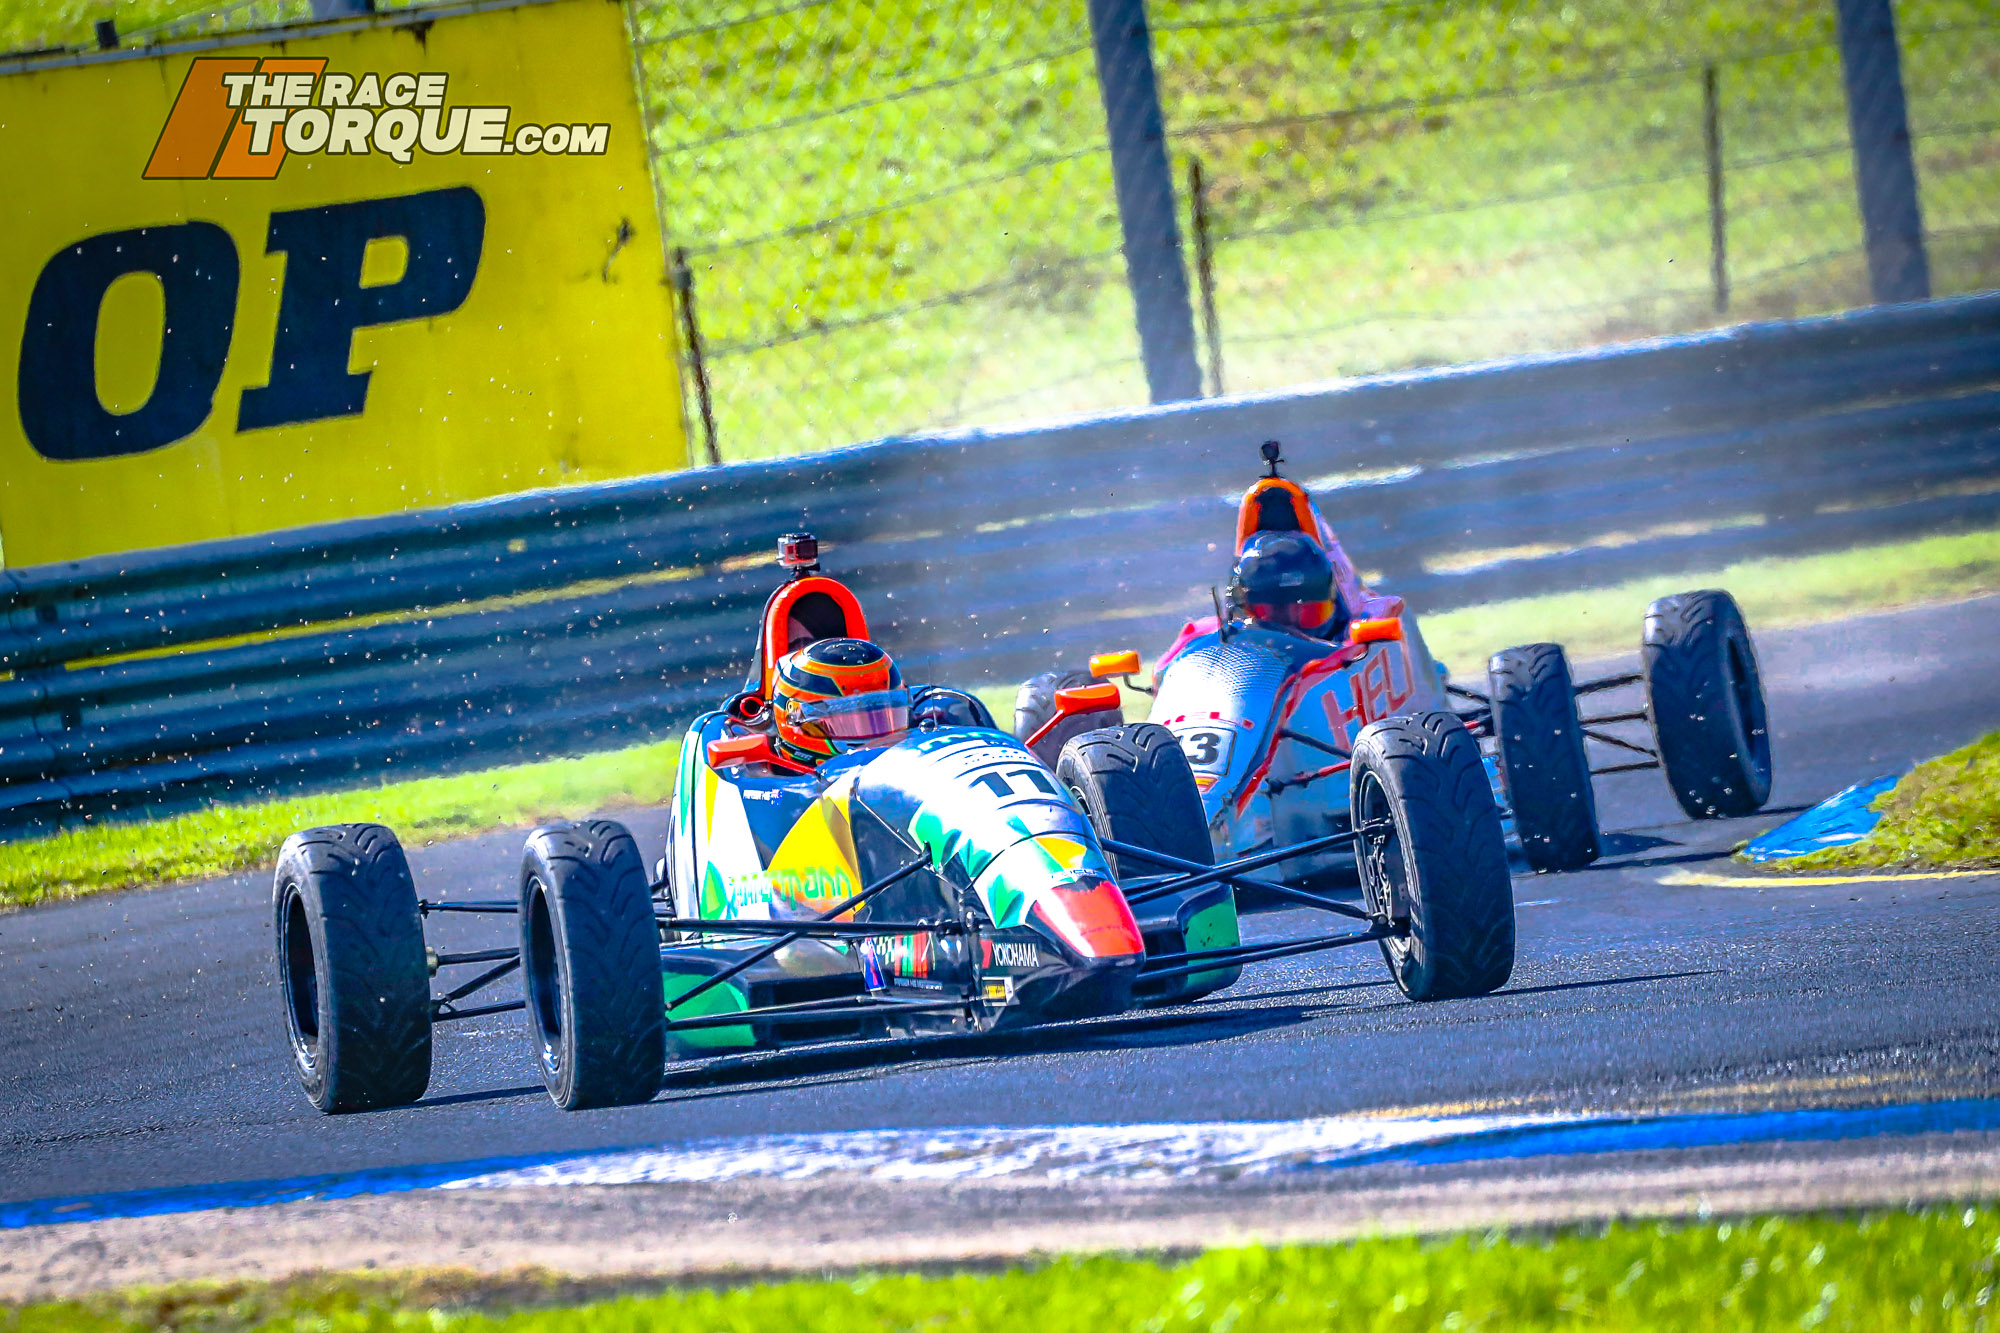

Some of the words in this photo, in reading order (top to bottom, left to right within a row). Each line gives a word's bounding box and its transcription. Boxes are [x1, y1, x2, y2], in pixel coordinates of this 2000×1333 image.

[17, 185, 486, 462] OP
[968, 769, 1058, 798] 11
[992, 942, 1040, 968] YOKOHAMA
